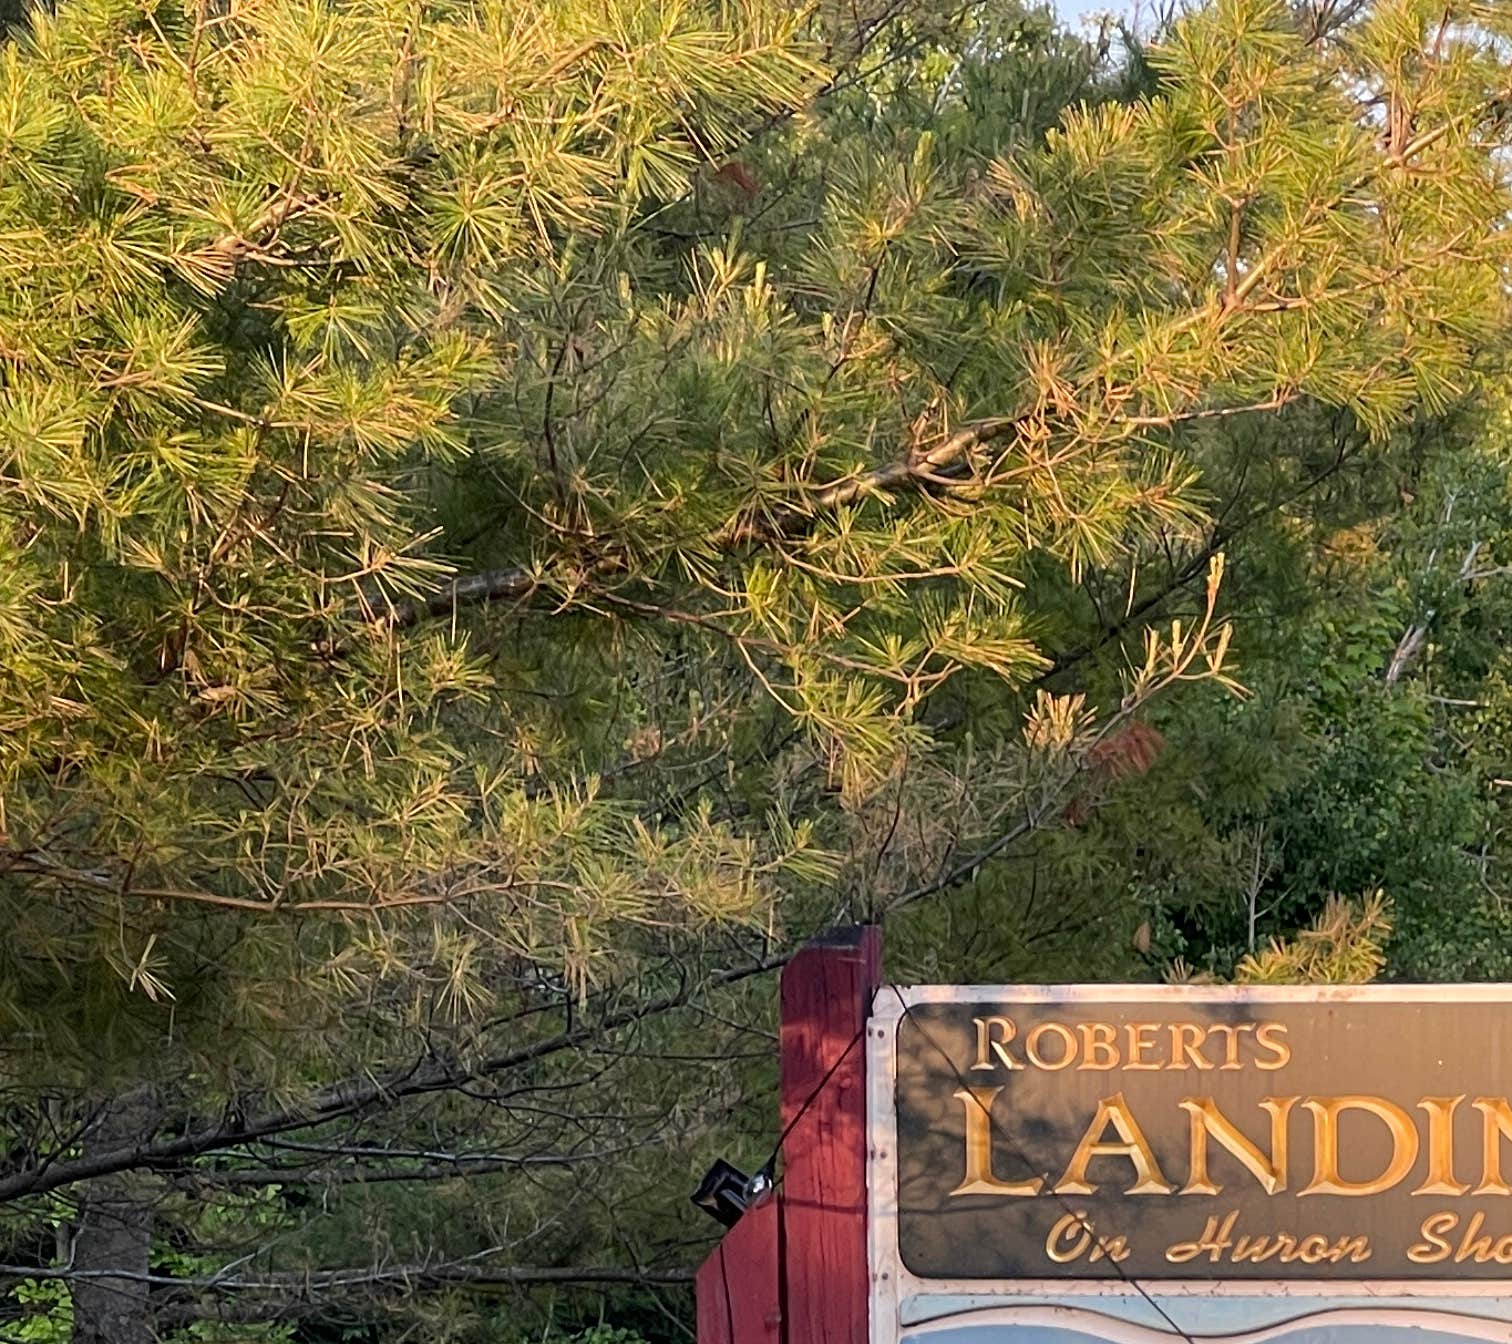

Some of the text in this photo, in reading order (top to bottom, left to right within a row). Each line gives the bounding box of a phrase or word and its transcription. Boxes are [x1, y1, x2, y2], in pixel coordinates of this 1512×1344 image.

[970, 1015, 1292, 1071] ROBERTS
[1045, 1210, 1131, 1264] On
[1164, 1210, 1373, 1265] Huron
